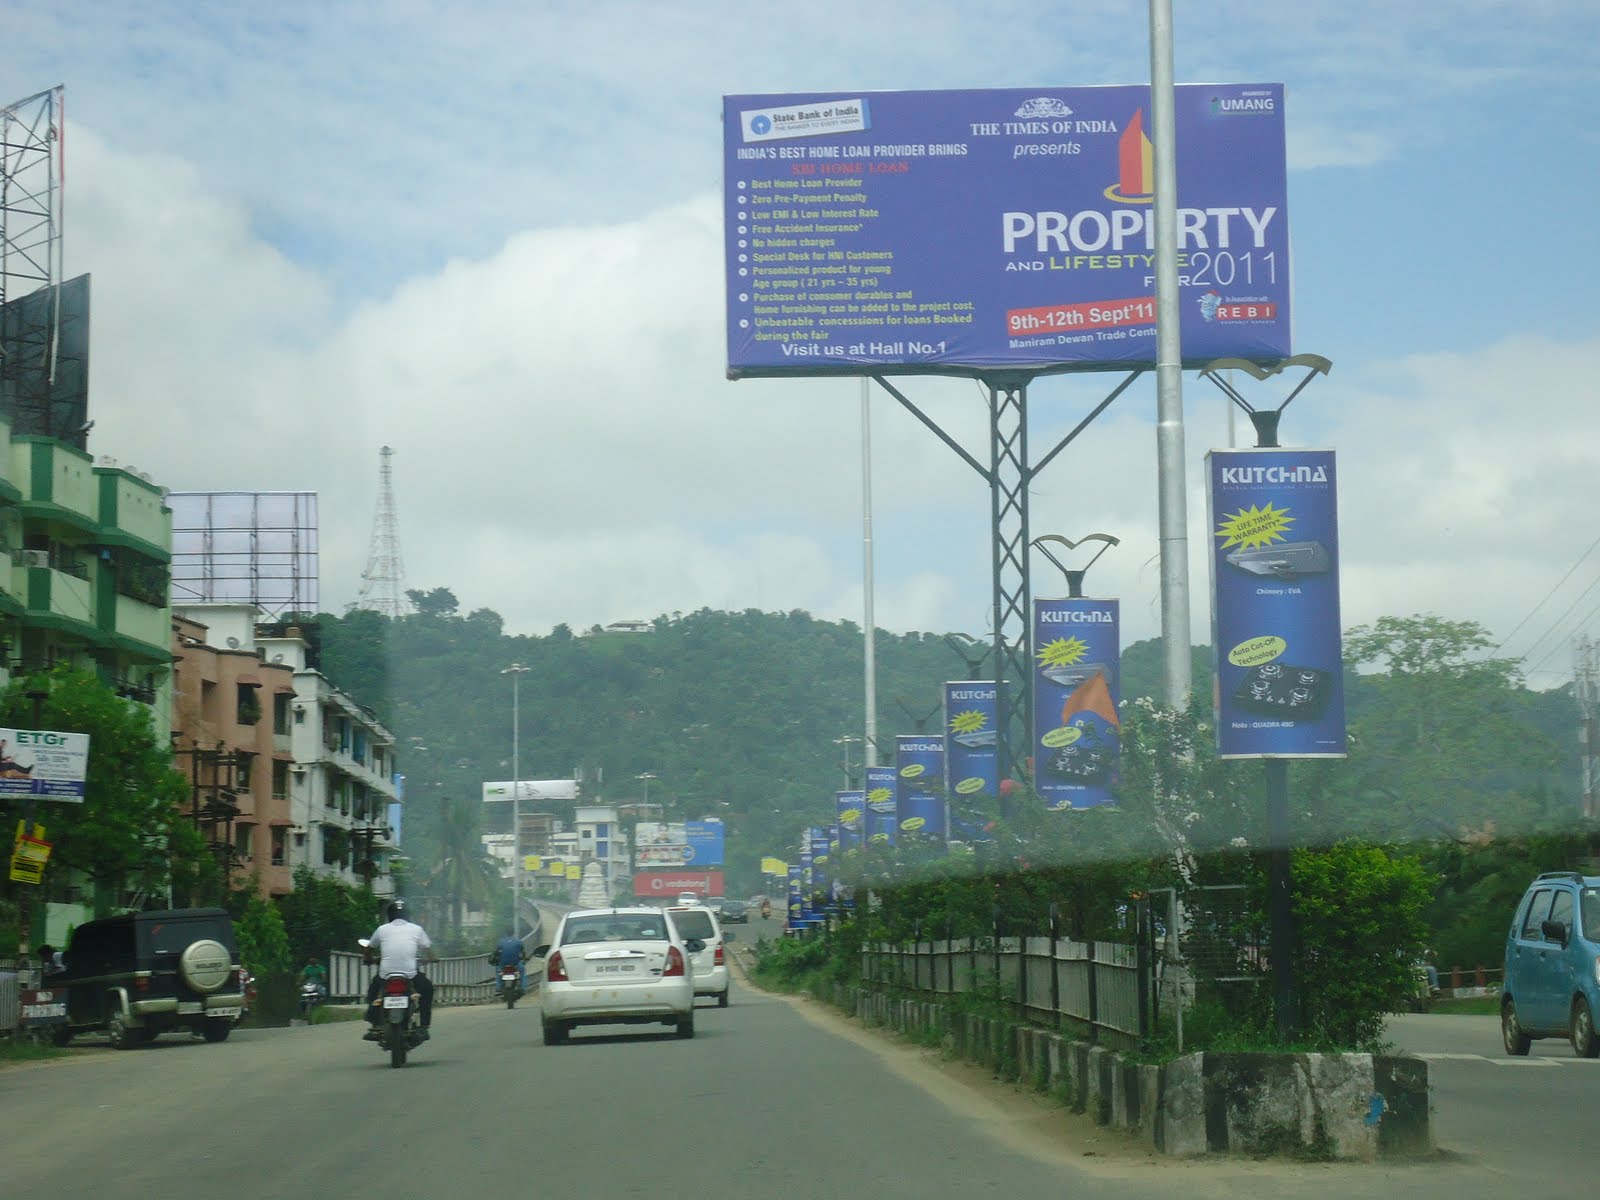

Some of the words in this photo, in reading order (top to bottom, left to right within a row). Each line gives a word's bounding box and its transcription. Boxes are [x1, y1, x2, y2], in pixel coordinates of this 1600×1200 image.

[1221, 98, 1274, 110] UMANG
[773, 113, 795, 123] State
[798, 109, 821, 119] Bank
[824, 108, 832, 118] of
[835, 106, 859, 116] India
[970, 123, 1000, 136] THE
[1003, 121, 1049, 135] TIMES
[1052, 121, 1072, 134] OF
[1076, 120, 1118, 133] INDIA
[737, 148, 776, 160] INDIA'S
[779, 146, 807, 159] BEST
[809, 146, 840, 158] HOME
[843, 145, 870, 157] LOAN
[874, 144, 926, 157] PROVIDER
[928, 144, 968, 156] BRINGS
[1013, 142, 1082, 160] presents
[791, 163, 816, 175] SBI
[820, 162, 864, 174] HOME
[869, 161, 910, 174] LOAN
[752, 179, 772, 189] Best
[774, 179, 799, 189] Home
[801, 178, 823, 188] Loan
[825, 178, 864, 188] Provider
[752, 194, 772, 204] Zero
[774, 194, 832, 205] Pre-Payment
[834, 193, 868, 203] Penalty
[752, 211, 770, 220] Low
[772, 210, 790, 219] EMI
[792, 210, 799, 218] &
[801, 210, 819, 219] Low
[822, 209, 857, 218] Interest
[859, 208, 879, 218] Rate
[752, 225, 772, 234] Free
[774, 224, 814, 234] Accident
[752, 238, 765, 248] No
[767, 238, 798, 248] hidden
[800, 238, 836, 249] charges
[752, 252, 786, 263] Special
[788, 252, 810, 261] Desk
[812, 252, 825, 260] for
[846, 250, 894, 260] Customers
[752, 266, 810, 275] Personalized
[812, 266, 847, 276] product
[849, 265, 862, 274] for
[864, 266, 892, 276] young
[1005, 261, 1044, 272] AND
[1049, 253, 1190, 270] LIFESTYE
[1191, 250, 1277, 286] 2011
[753, 279, 770, 289] Age
[772, 279, 799, 290] group
[807, 278, 818, 287] 21
[821, 279, 836, 288] yrs
[846, 278, 858, 286] 35
[860, 276, 878, 288] yrs)
[1144, 275, 1192, 288] FR
[754, 292, 796, 302] Purchase
[797, 292, 808, 301] of
[808, 293, 852, 302] consumer
[854, 290, 894, 300] durables
[895, 290, 912, 300] and
[754, 306, 779, 314] Home
[781, 304, 828, 316] furnishing
[829, 306, 846, 314] can
[848, 304, 860, 313] be
[861, 303, 889, 312] added
[891, 303, 900, 312] to
[902, 302, 917, 312] the
[919, 302, 951, 313] project
[953, 302, 975, 311] cost.
[754, 318, 814, 327] Unbeatable
[886, 316, 902, 326] for
[904, 315, 932, 324] loans
[933, 314, 973, 324] Booked
[1011, 308, 1084, 331] 9th-12th
[1090, 303, 1154, 324] Sept'11
[754, 332, 790, 343] during
[792, 331, 809, 340] the
[810, 330, 829, 340] fair
[1009, 336, 1056, 350] Maniram
[1057, 332, 1094, 346] Dewan
[1096, 328, 1127, 342] Trade
[781, 343, 820, 356] Visit
[824, 345, 844, 356] us
[848, 344, 866, 356] at
[870, 342, 904, 355] Hall
[908, 341, 946, 355] No.1
[1236, 521, 1252, 531] LIFE
[1252, 512, 1272, 524] TIME
[1256, 588, 1284, 596] Chimney
[1232, 648, 1250, 658] Auto
[1250, 637, 1276, 652] Cut-Off
[1236, 648, 1278, 666] Technology
